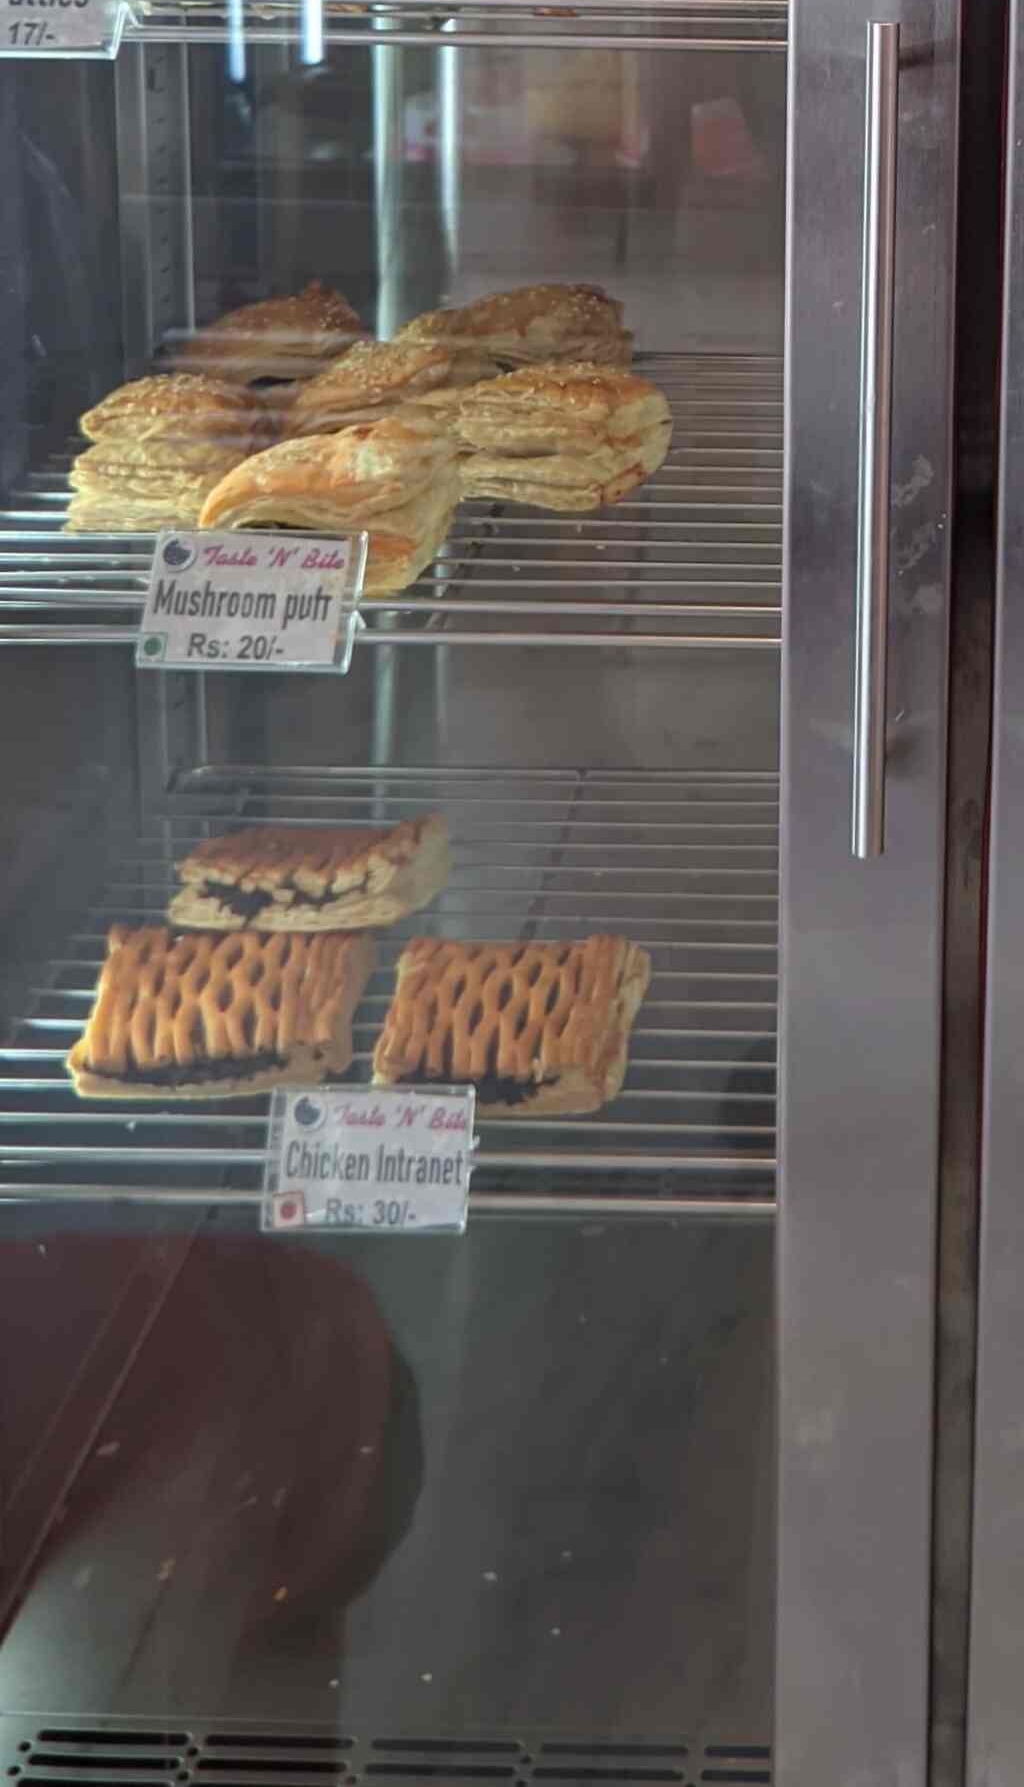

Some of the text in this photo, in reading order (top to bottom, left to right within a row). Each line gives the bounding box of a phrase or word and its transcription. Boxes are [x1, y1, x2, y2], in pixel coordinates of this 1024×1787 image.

[8, 21, 55, 46] 17/-
[203, 545, 258, 567] Taste
[301, 548, 345, 570] Bite
[153, 580, 277, 617] Mushroom
[187, 632, 286, 661] Rs: 20/-
[335, 1103, 386, 1128] Taste
[285, 1140, 464, 1185] Chicken Intranet
[325, 1197, 416, 1228] Rs: 30/-
